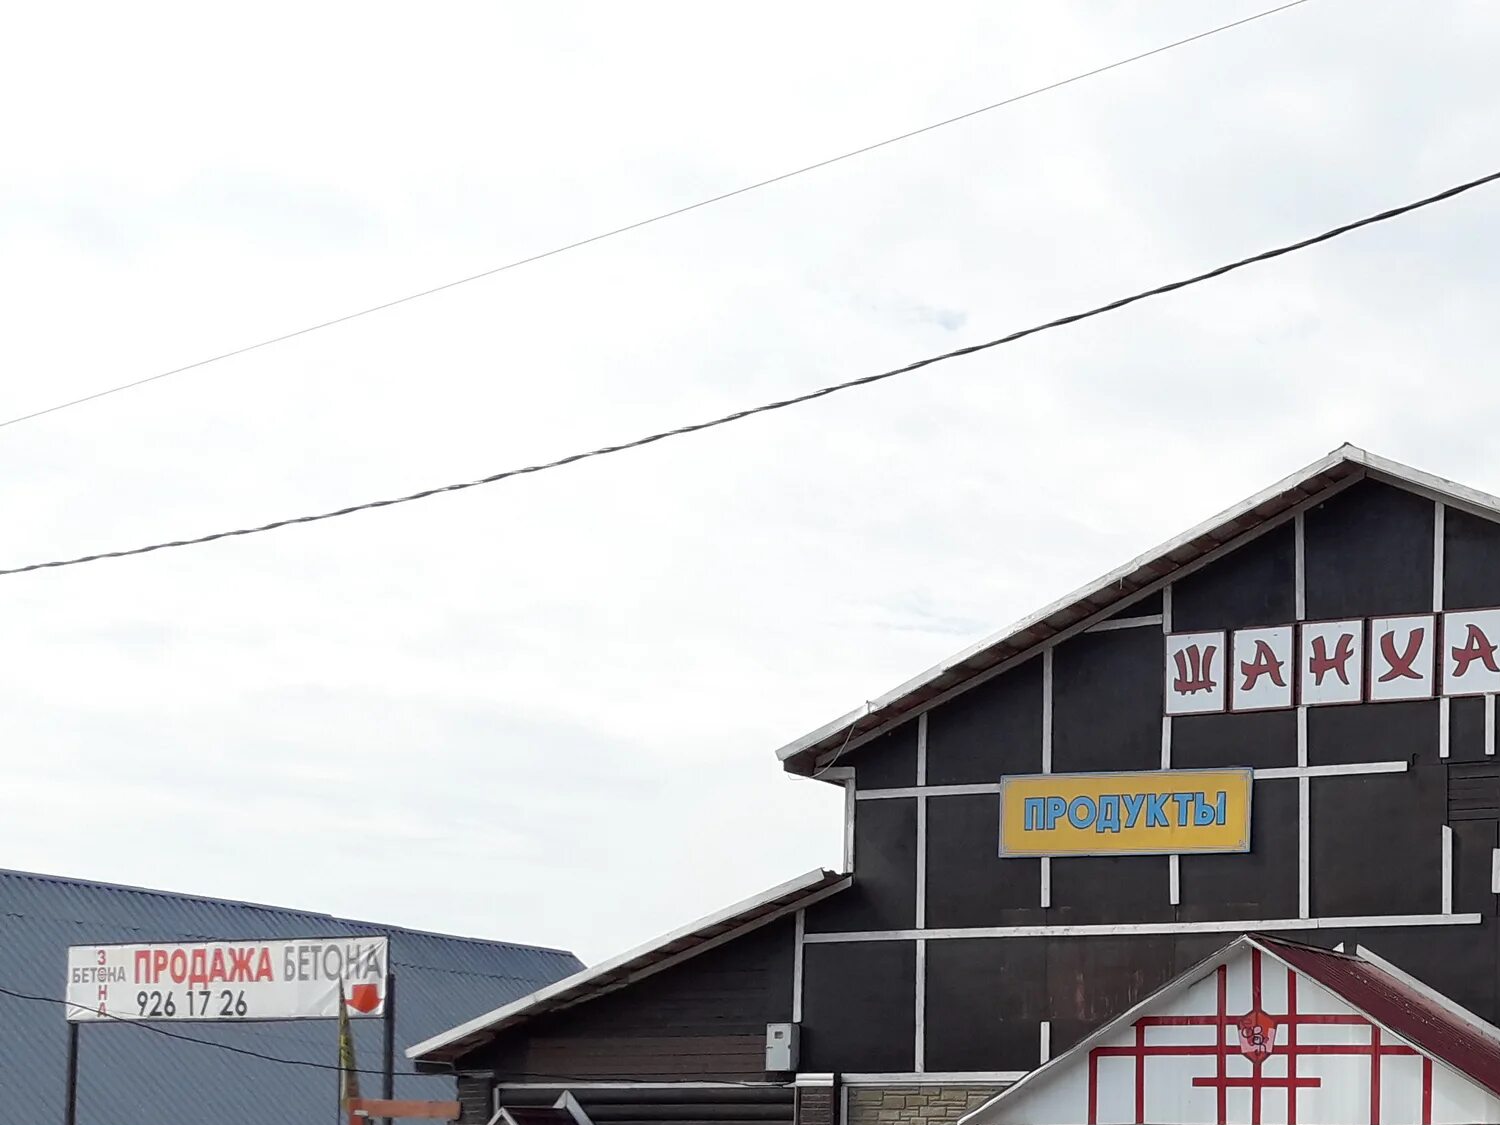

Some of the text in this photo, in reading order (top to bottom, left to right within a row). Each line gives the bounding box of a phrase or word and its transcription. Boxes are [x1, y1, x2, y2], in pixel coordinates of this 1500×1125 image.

[1024, 791, 1227, 833] ПРОДУКТЫ
[72, 966, 127, 984] БЕТОНА
[133, 944, 384, 989] ПРОДАЖА БЕТОНА
[136, 989, 248, 1017] 926 17 26
